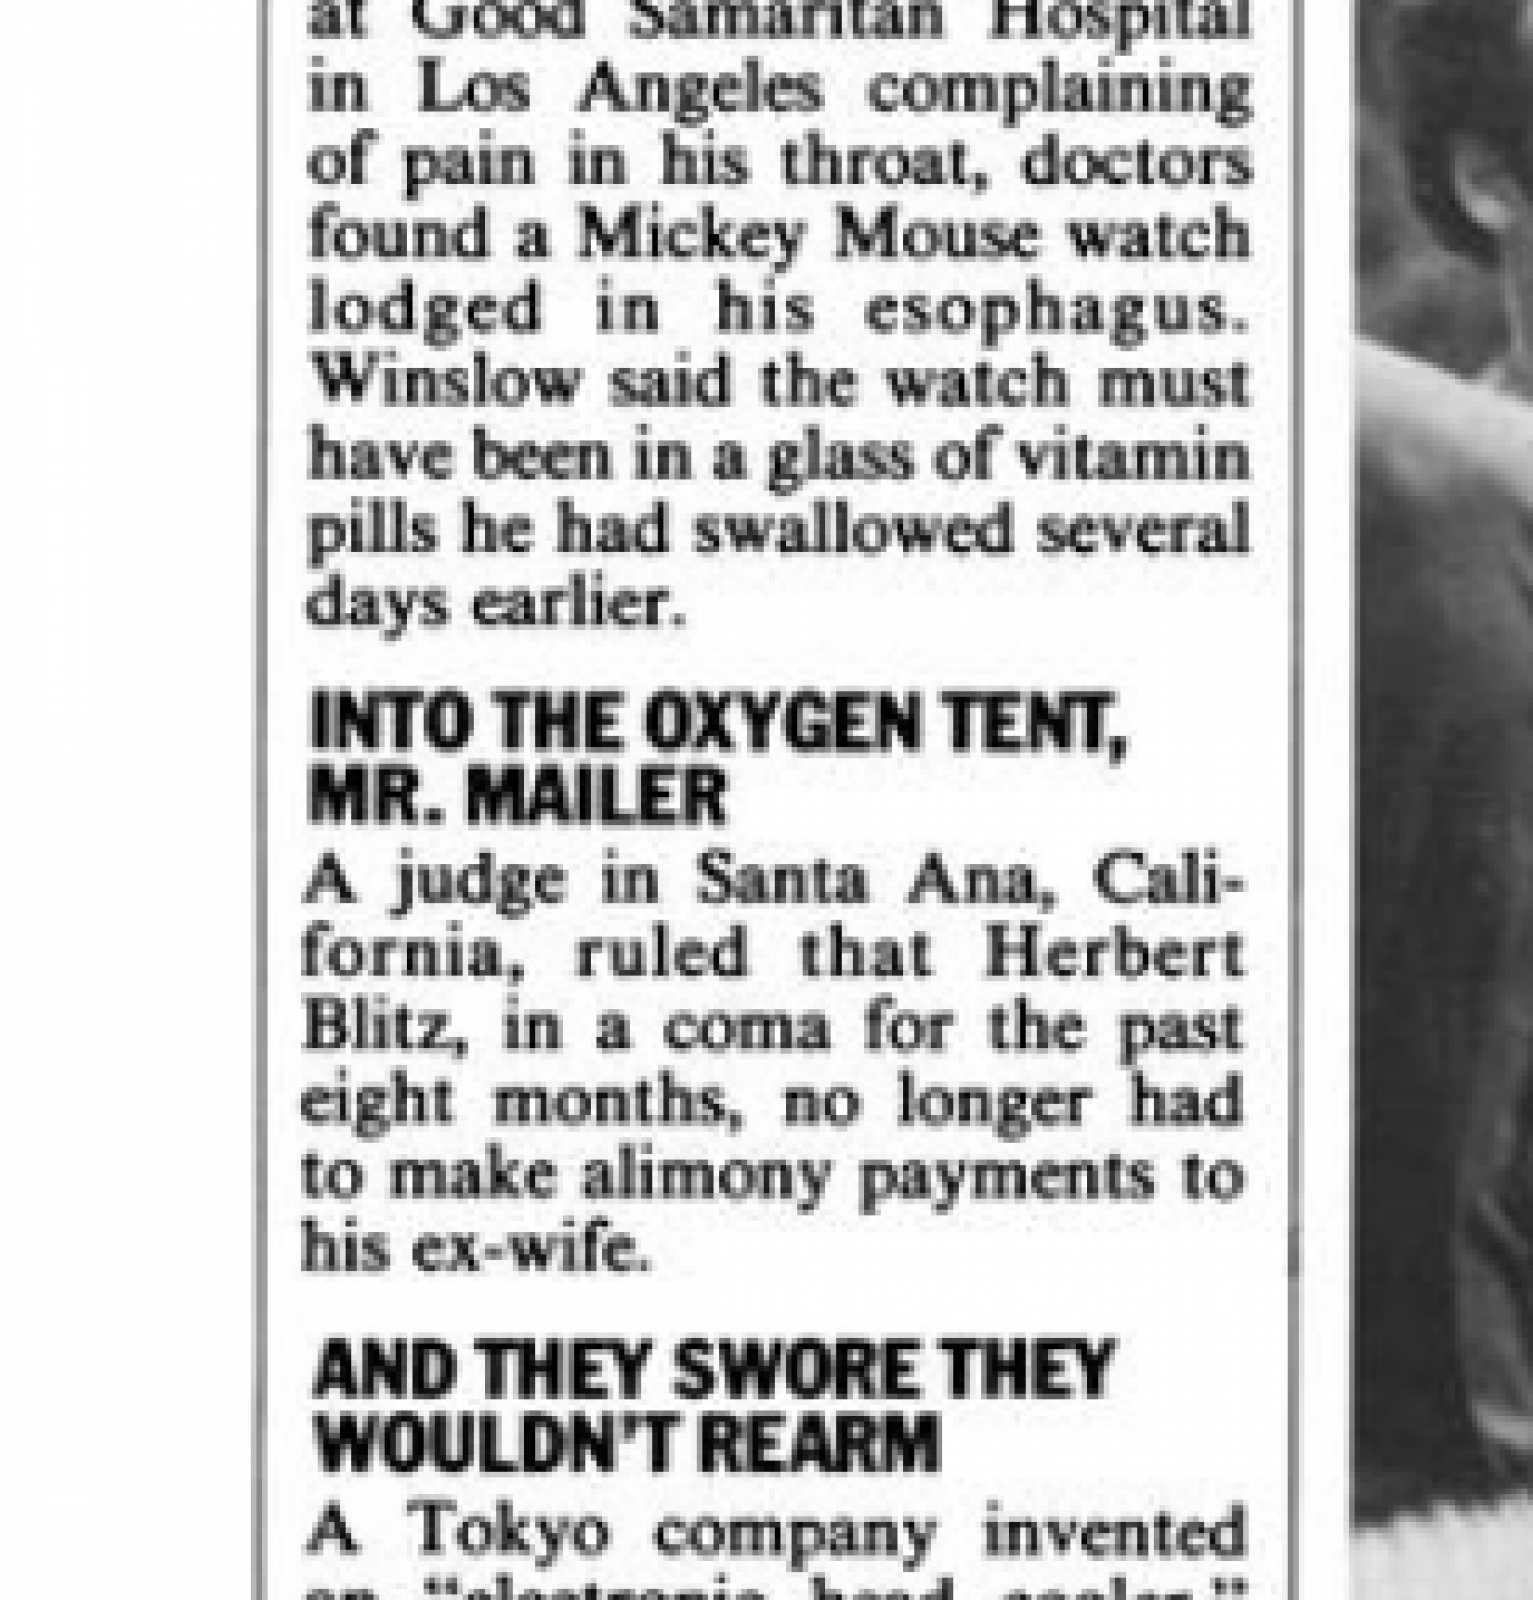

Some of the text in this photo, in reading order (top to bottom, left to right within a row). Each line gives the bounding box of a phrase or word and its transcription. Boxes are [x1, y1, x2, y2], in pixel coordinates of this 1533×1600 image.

[306, 0, 1251, 55] at Good Samaritan Hospital
[311, 55, 1256, 129] in Los Angeles complaining
[306, 129, 1256, 202] of pain in his throat, doctors
[311, 200, 1251, 274] found a Mickey Mouse watch
[311, 277, 1245, 351] lodged in his esophagus.
[311, 350, 1251, 408] Winslow said the watch must
[311, 423, 1251, 497] have been in a glass of vitamin
[306, 497, 1251, 570] pills he had swallowed several
[305, 570, 687, 642] days earlier.
[310, 688, 1132, 767] INTO THE OXYGEN TENT,
[306, 762, 732, 826] MR. MAILER
[300, 846, 1245, 921] A judge in Santa Ana, Cali-
[300, 920, 1245, 987] fornia, ruled that Herbert
[305, 994, 1245, 1066] Blitz, in a coma for the past
[300, 1069, 1245, 1142] eight months, no longer had
[300, 1142, 1245, 1215] to make alimony payments to
[300, 1214, 649, 1272] his ex-wife.
[309, 1334, 1120, 1402] AND THEY SWORE THEY
[311, 1410, 944, 1473] WOULDN'T REARM
[306, 1499, 1246, 1573] A Tokyo company invented
